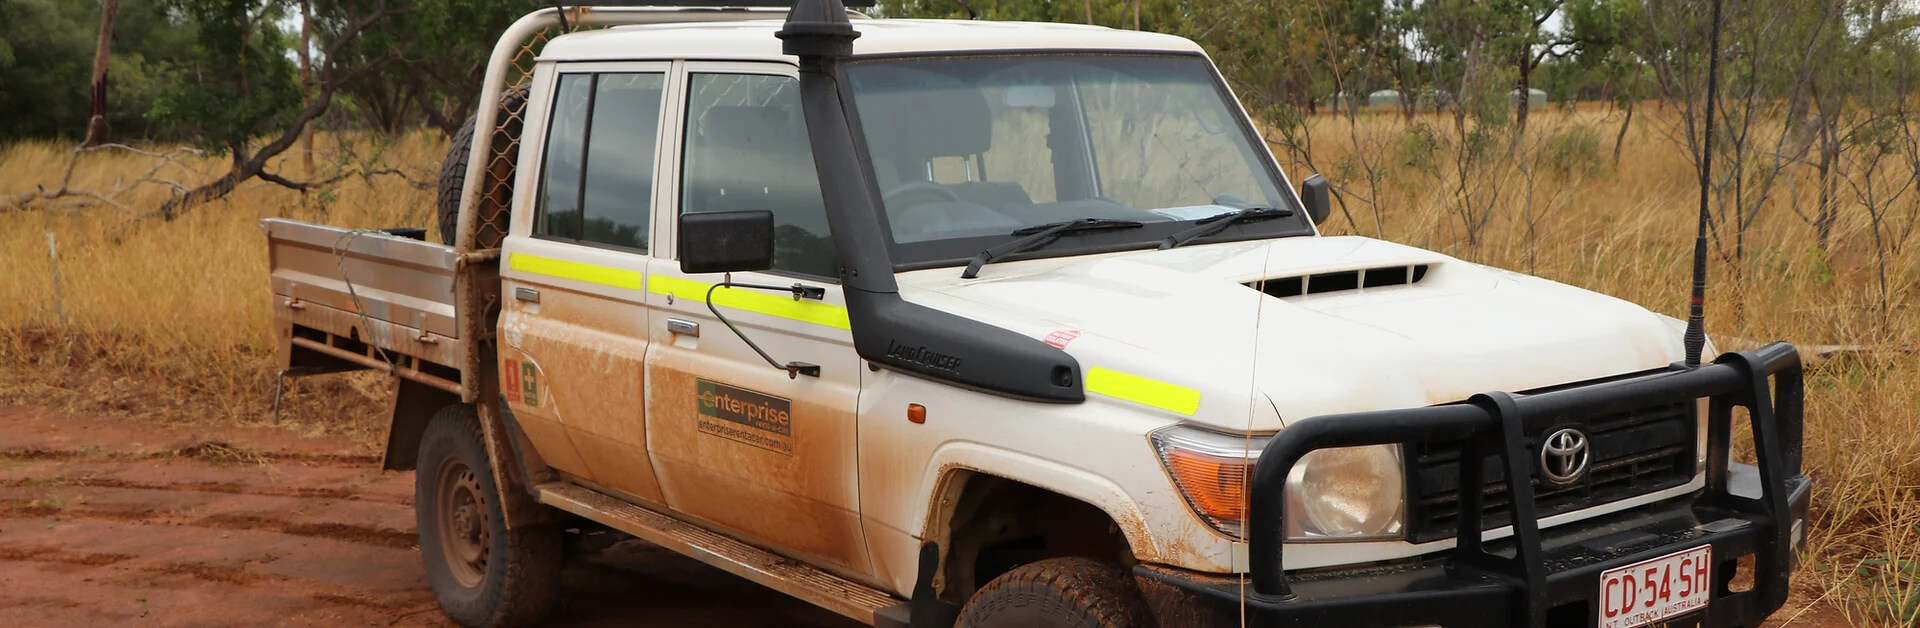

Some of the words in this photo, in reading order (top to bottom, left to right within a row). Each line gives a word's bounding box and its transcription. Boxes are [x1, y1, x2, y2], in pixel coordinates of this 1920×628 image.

[702, 390, 789, 425] enterprise
[698, 420, 792, 452] enterpriserentacar.com.au
[1625, 610, 1659, 626] OUTBACK
[1664, 597, 1701, 614] AUSTRALIA
